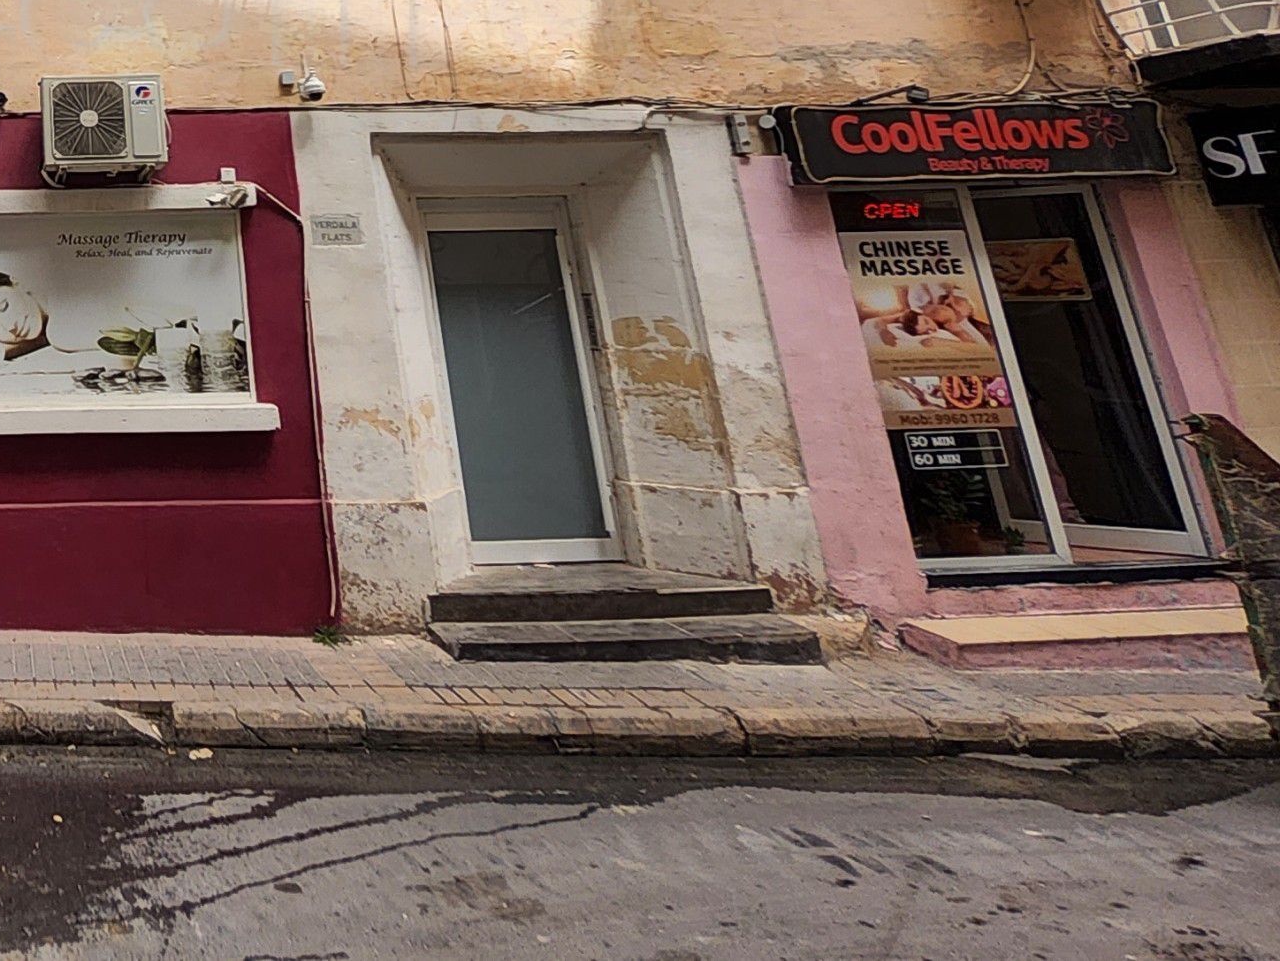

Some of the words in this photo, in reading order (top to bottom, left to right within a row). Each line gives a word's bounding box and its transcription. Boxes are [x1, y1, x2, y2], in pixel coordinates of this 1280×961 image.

[831, 108, 1089, 154] CoolFellows
[927, 157, 978, 174] Beauty
[980, 157, 992, 171] &
[993, 156, 1049, 172] Therapy
[863, 203, 919, 219] OPEN
[57, 233, 120, 248] Massage
[123, 230, 186, 247] Therapy
[321, 232, 352, 242] FLATS
[75, 248, 105, 258] Relax,
[135, 247, 153, 256] and
[859, 240, 951, 258] CHINESE
[860, 258, 965, 277] MASSAGE
[899, 414, 932, 426] Mob:
[909, 436, 928, 447] 30
[931, 436, 956, 447] MIN
[914, 454, 934, 465] 60
[937, 454, 962, 464] MIN
